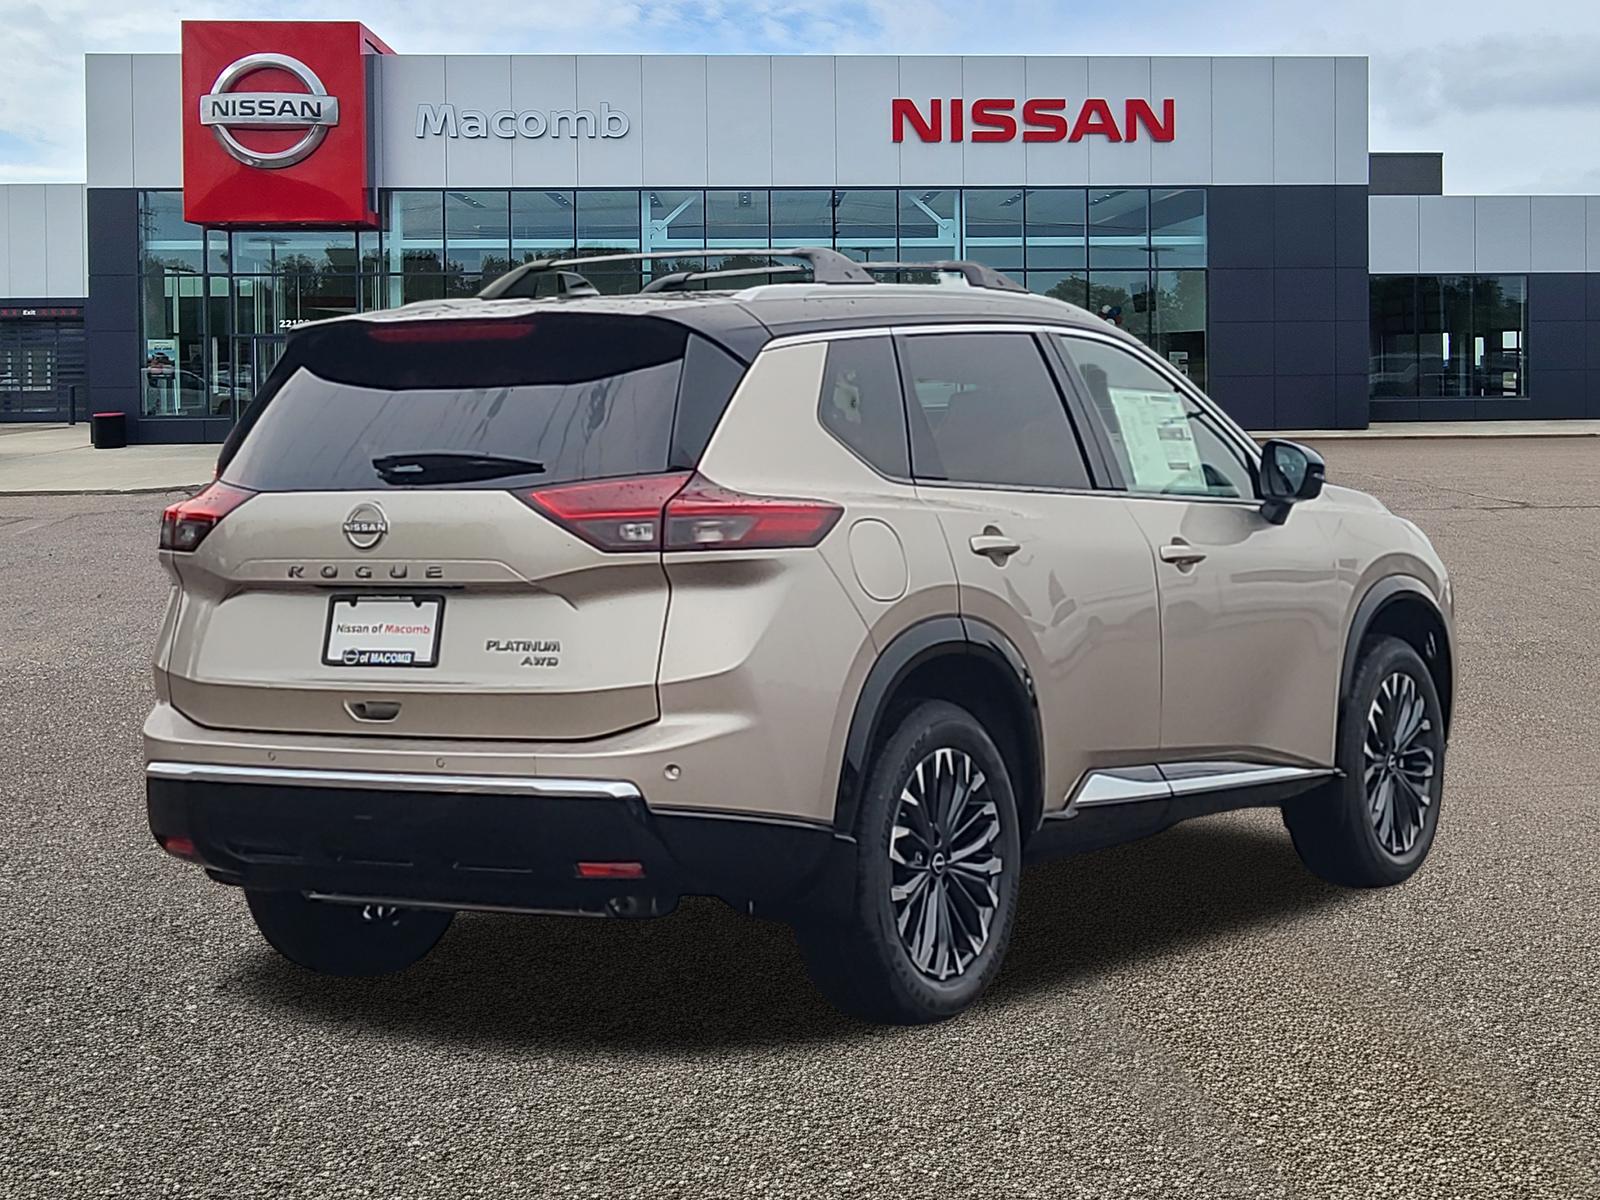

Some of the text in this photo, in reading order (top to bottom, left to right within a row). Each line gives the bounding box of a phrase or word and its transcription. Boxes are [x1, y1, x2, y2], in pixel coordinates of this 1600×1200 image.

[211, 100, 322, 117] NISSAN
[415, 102, 630, 139] Macomb
[892, 98, 1176, 143] NISSAN
[343, 522, 387, 533] NISSAN
[287, 565, 443, 579] ROGUE
[336, 623, 430, 635] Nissan of Macomb
[485, 639, 561, 652] PLATINUM
[370, 652, 412, 664] MACOMB
[520, 656, 559, 667] AWD
